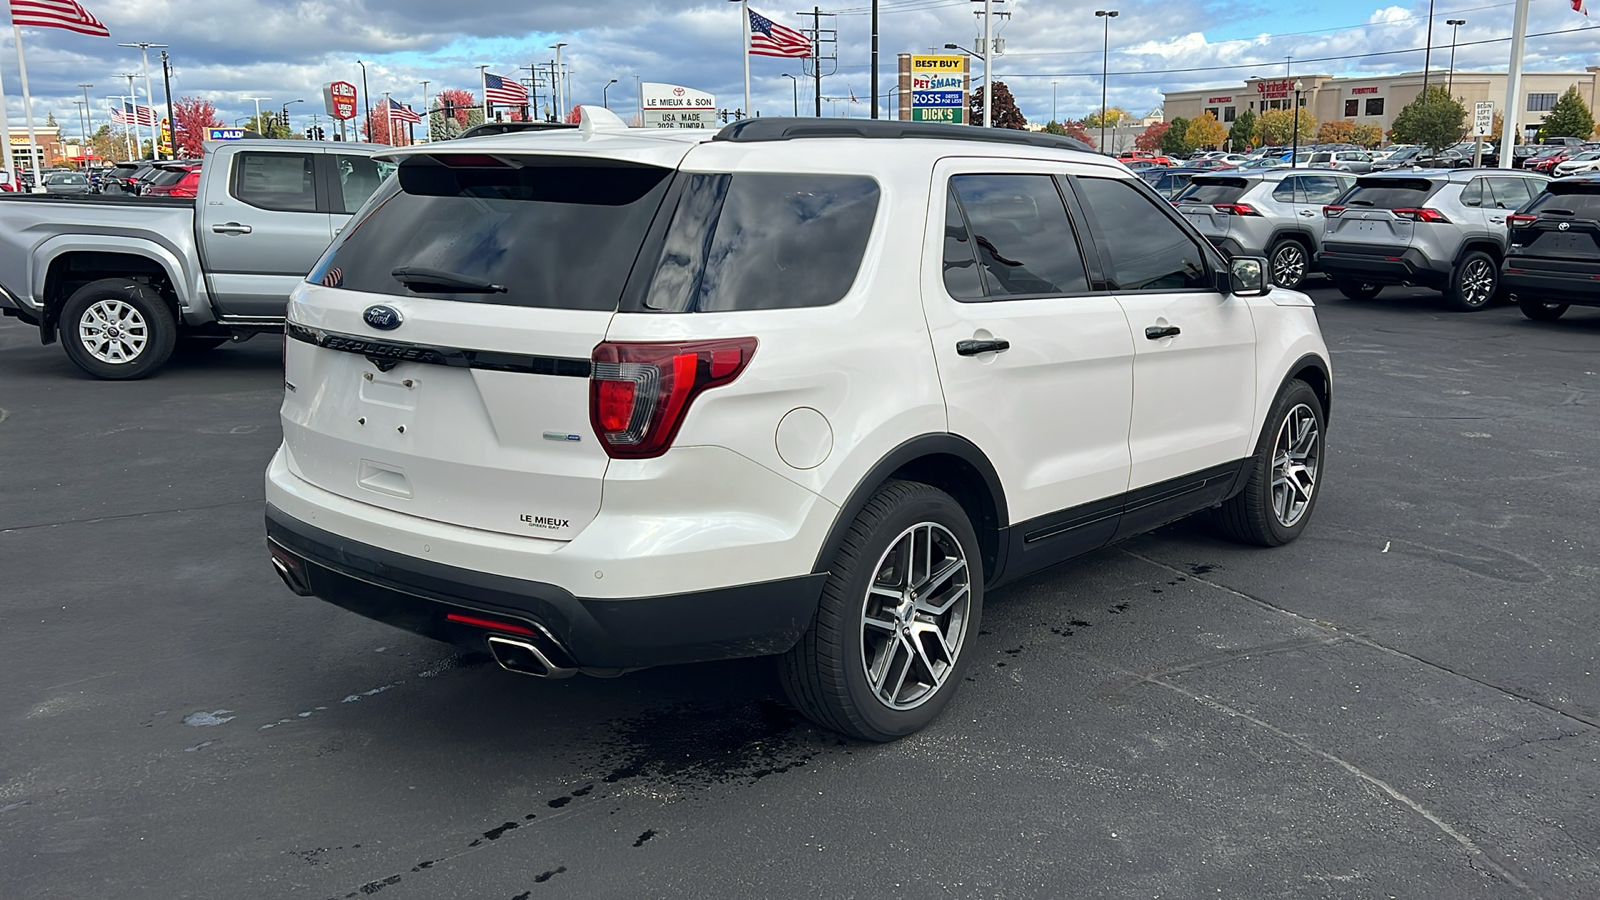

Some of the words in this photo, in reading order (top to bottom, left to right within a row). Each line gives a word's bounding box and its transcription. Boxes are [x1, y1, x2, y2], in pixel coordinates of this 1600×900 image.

[912, 94, 941, 104] ROSS
[922, 109, 953, 120] DICK'S
[367, 307, 391, 325] Ford
[326, 338, 434, 361] EXPLORER
[520, 514, 532, 522] LE
[534, 516, 569, 528] MIEUX
